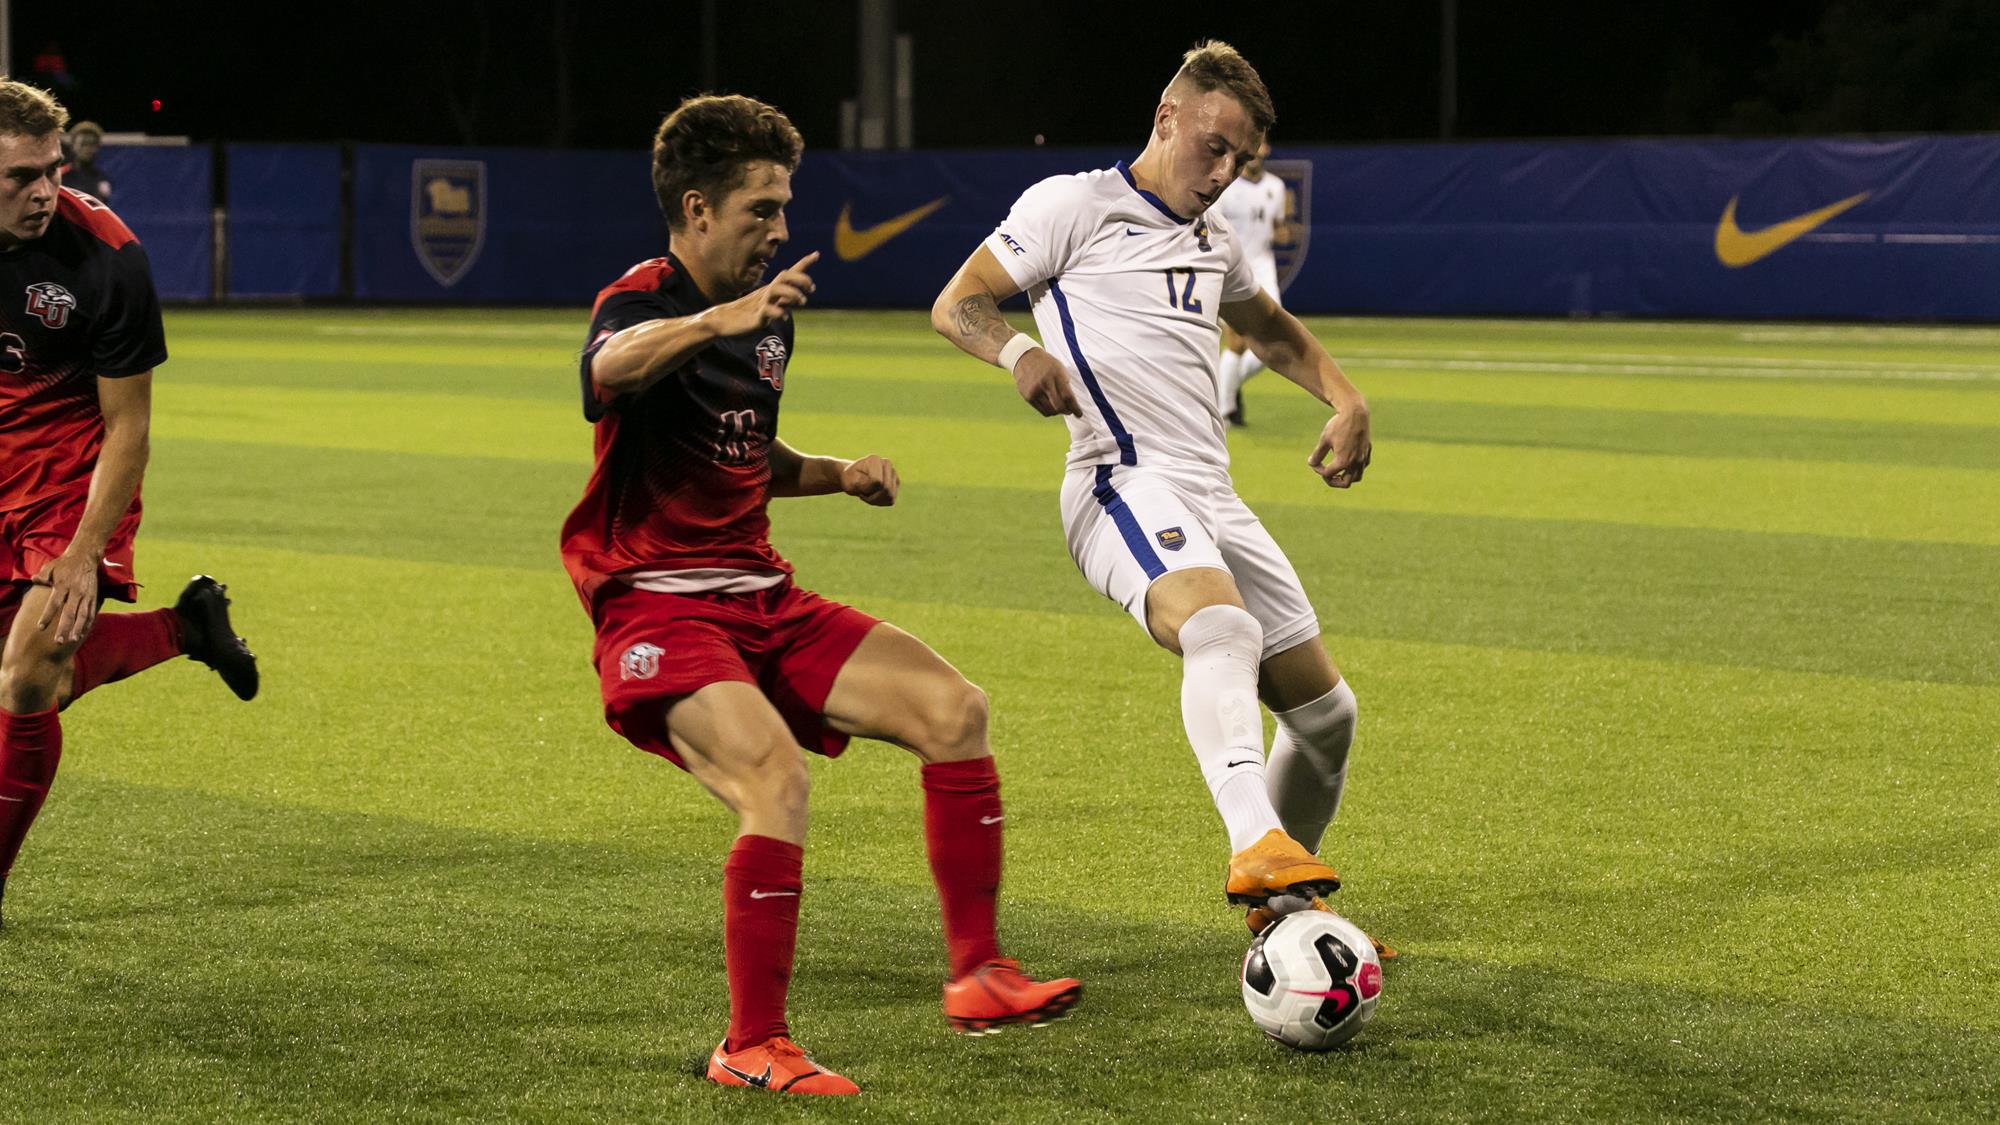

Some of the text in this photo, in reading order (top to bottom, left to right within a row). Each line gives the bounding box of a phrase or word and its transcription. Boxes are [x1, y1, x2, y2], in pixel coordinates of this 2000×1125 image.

[1000, 233, 1027, 256] ACC
[25, 286, 71, 329] LU
[1166, 268, 1202, 315] 12
[712, 409, 756, 462] 11
